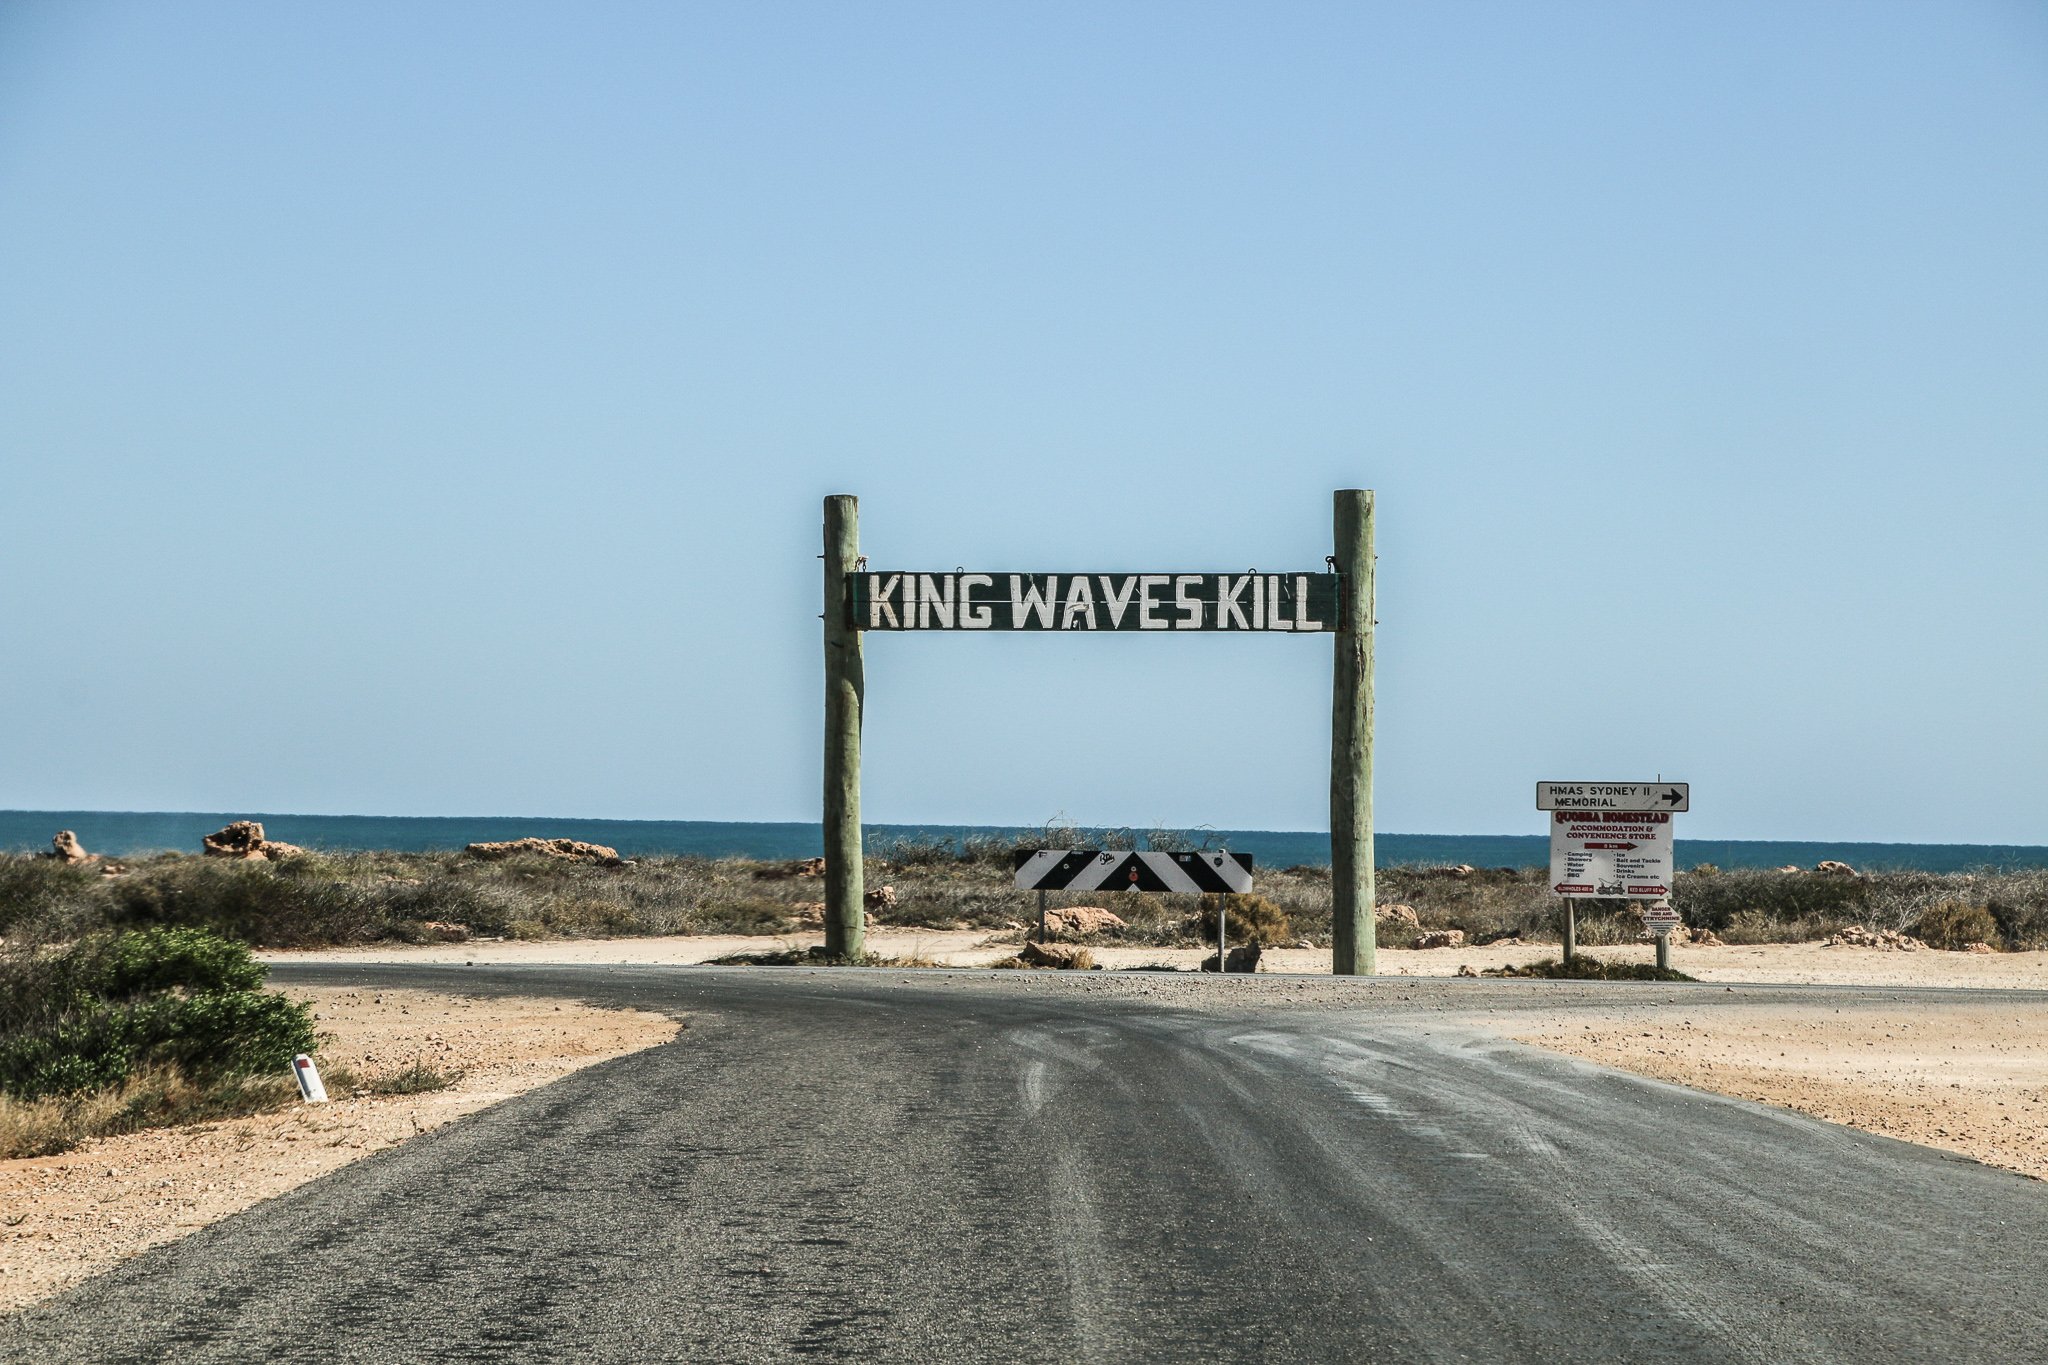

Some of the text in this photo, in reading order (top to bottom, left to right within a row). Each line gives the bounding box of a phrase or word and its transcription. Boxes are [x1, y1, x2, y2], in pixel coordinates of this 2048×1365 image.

[869, 573, 1323, 630] KING WAVES KILL
[1549, 786, 1650, 796] HMAS SYDNEY II
[1555, 797, 1617, 807] MEMORIAL
[1602, 811, 1669, 823] HOMESTEAD
[1566, 832, 1627, 840] CONVENIENCE
